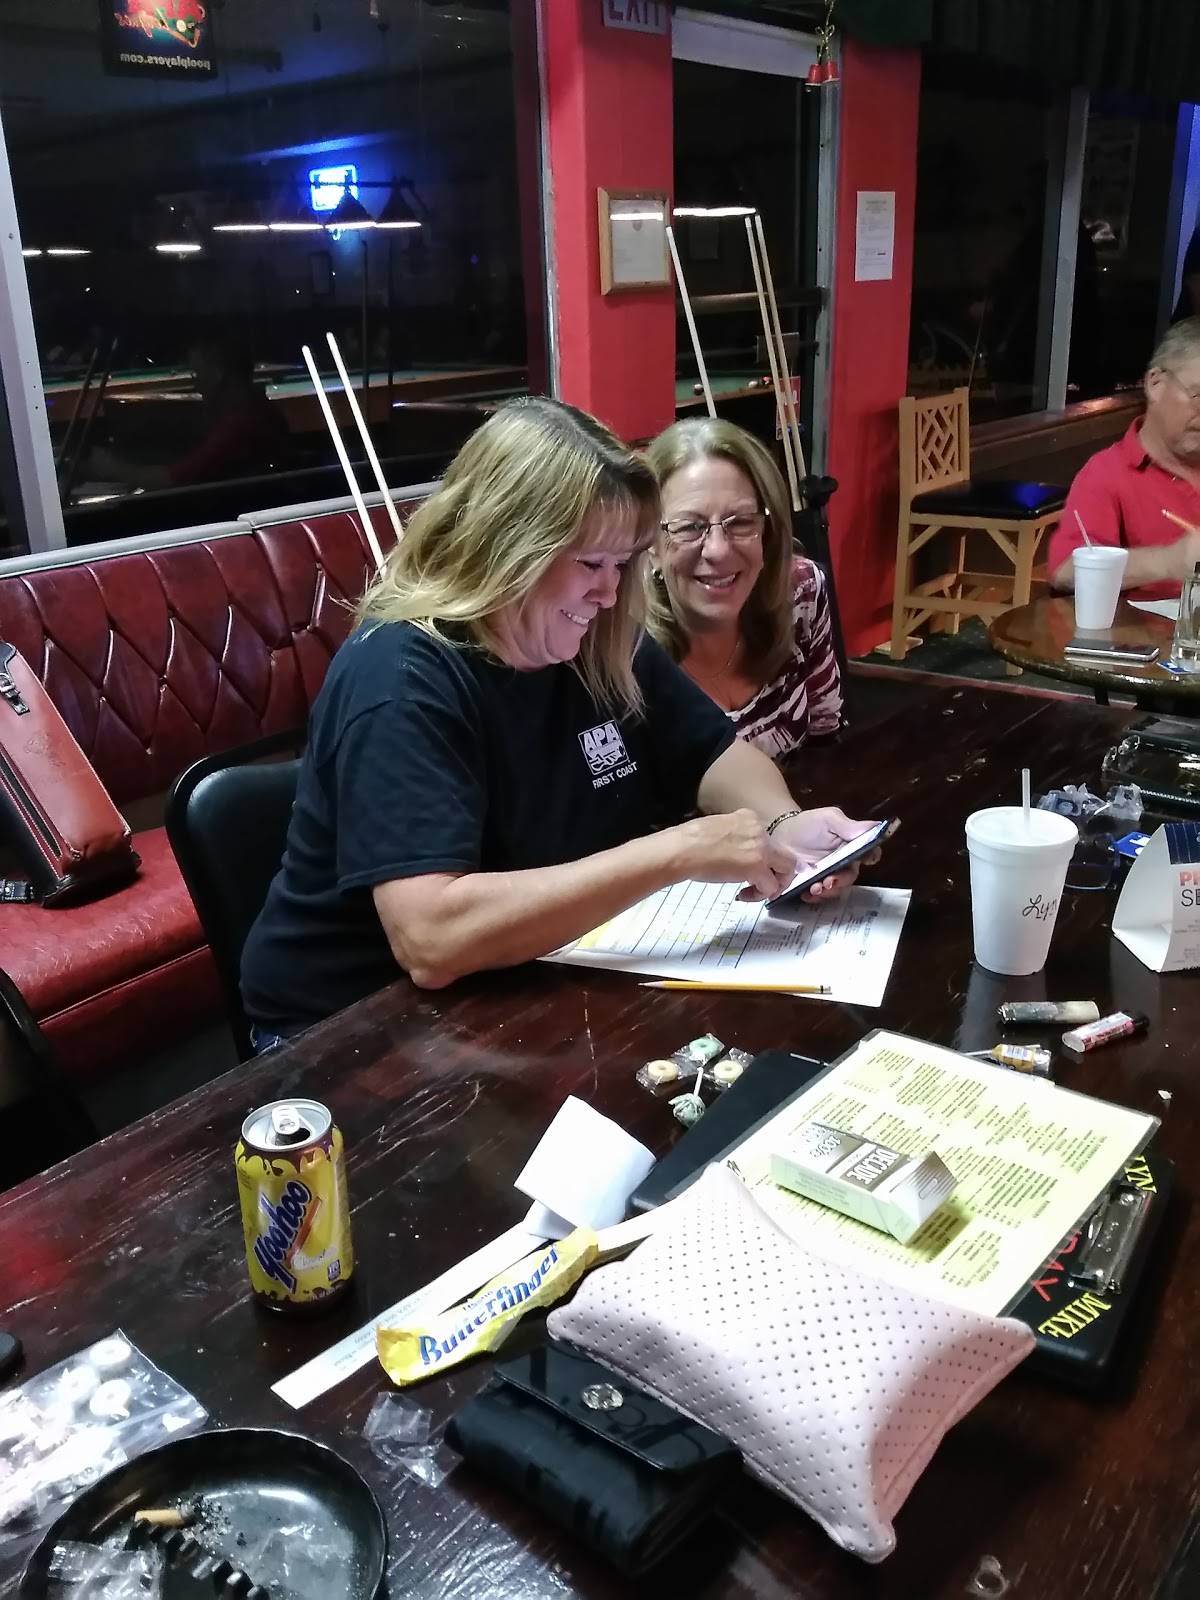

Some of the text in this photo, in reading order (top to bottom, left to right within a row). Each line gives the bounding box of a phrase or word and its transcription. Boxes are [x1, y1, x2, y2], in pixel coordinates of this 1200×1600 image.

[583, 723, 621, 753] APA
[592, 761, 638, 789] FIRST COAST
[847, 1148, 900, 1185] DECADE
[1038, 1292, 1112, 1338] MIKE
